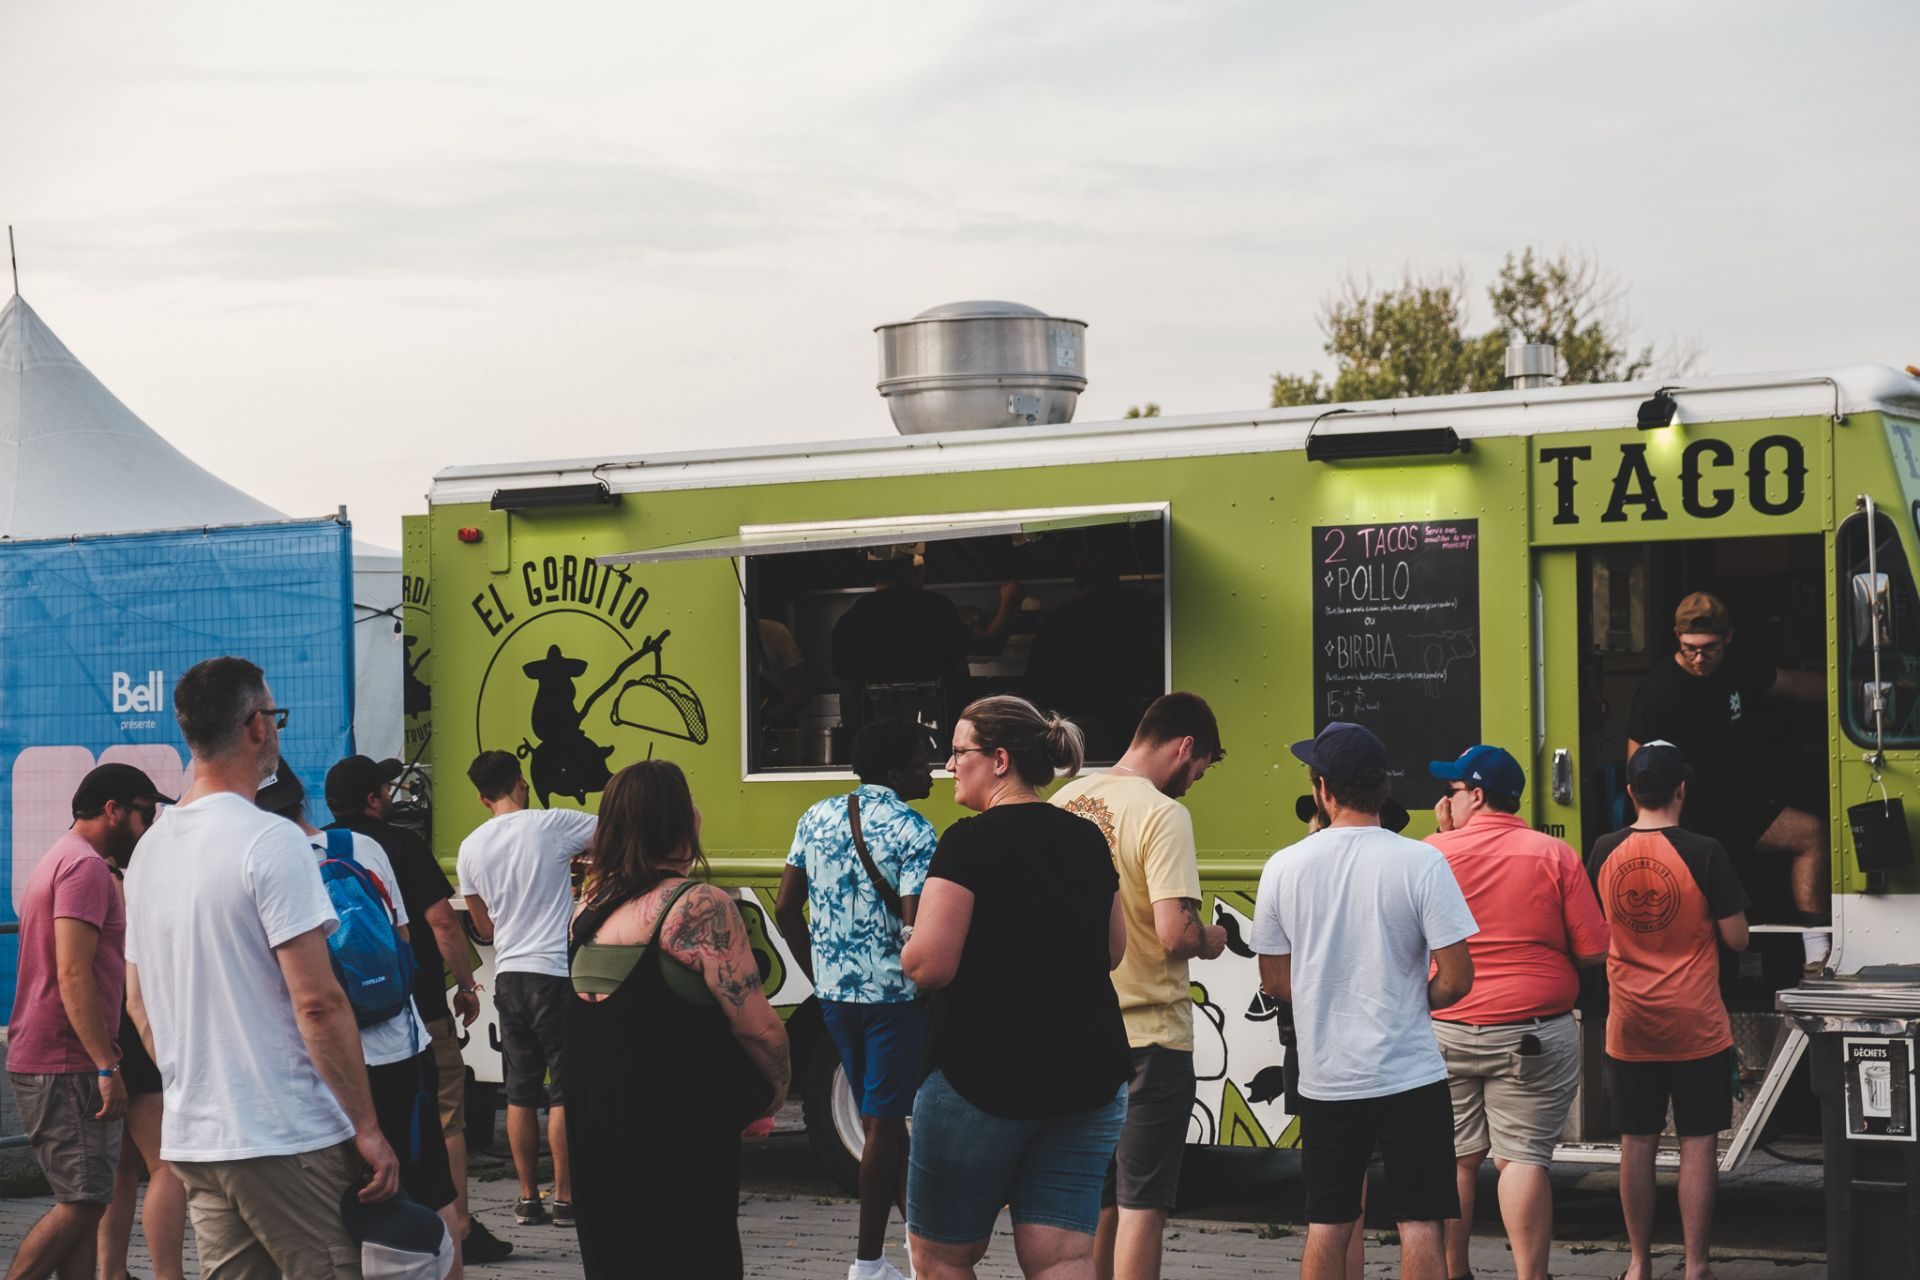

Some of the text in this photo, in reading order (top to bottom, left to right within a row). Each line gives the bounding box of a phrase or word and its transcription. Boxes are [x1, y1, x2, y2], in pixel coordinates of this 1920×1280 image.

[1539, 434, 1809, 525] TACO
[1324, 525, 1418, 564] 2 TACOS
[471, 555, 650, 637] EL GORDITO
[1338, 561, 1410, 601] POLLO
[1337, 632, 1398, 669] BIRRIA
[112, 670, 163, 713] Bell
[120, 719, 157, 731] présente
[1853, 1046, 1888, 1058] DÉCHETS
